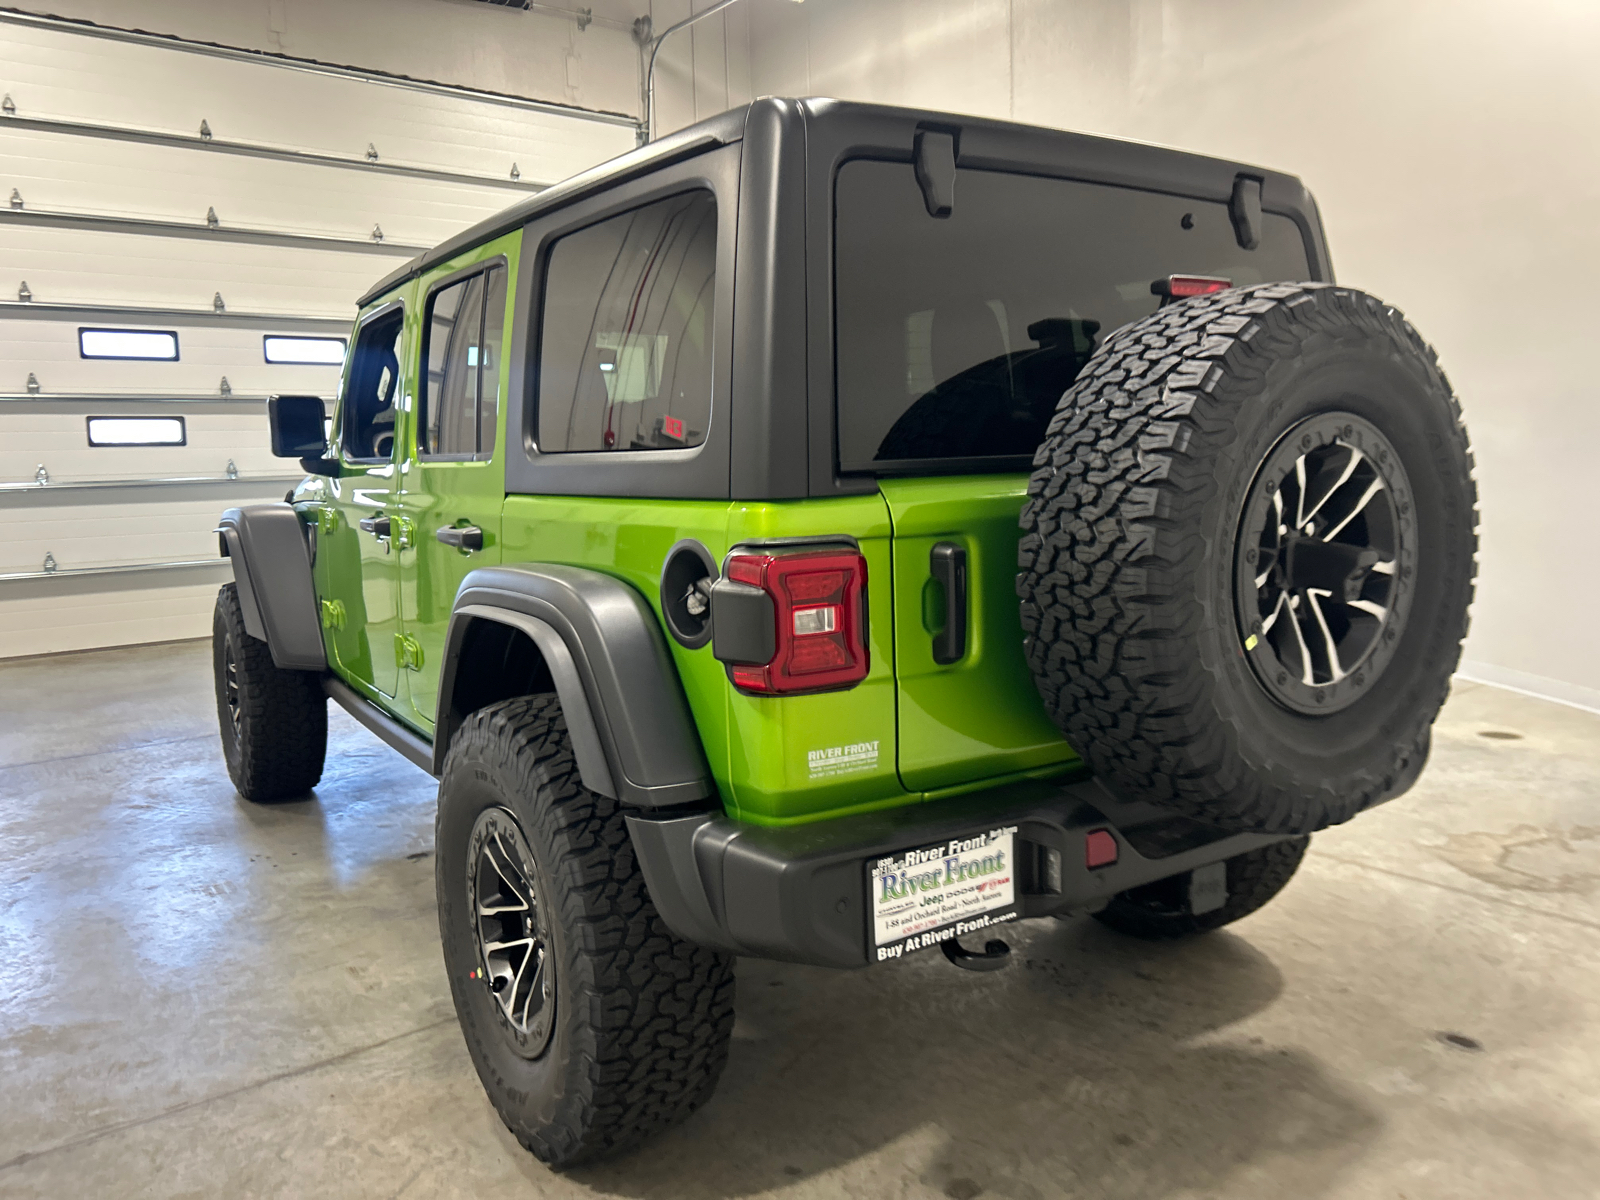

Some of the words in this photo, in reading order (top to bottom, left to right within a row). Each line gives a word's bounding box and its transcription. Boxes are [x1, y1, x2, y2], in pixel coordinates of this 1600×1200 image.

[808, 747, 842, 761] RIVER
[844, 740, 879, 756] FRONT
[905, 845, 945, 866] River
[948, 833, 986, 856] Front
[879, 868, 943, 904] River
[943, 849, 1006, 886] Front
[901, 914, 913, 924] and
[914, 907, 941, 921] Orchard
[941, 901, 958, 913] Road
[919, 892, 945, 907] Jeep
[877, 943, 903, 961] Buy
[905, 937, 921, 952] At
[921, 927, 956, 947] River
